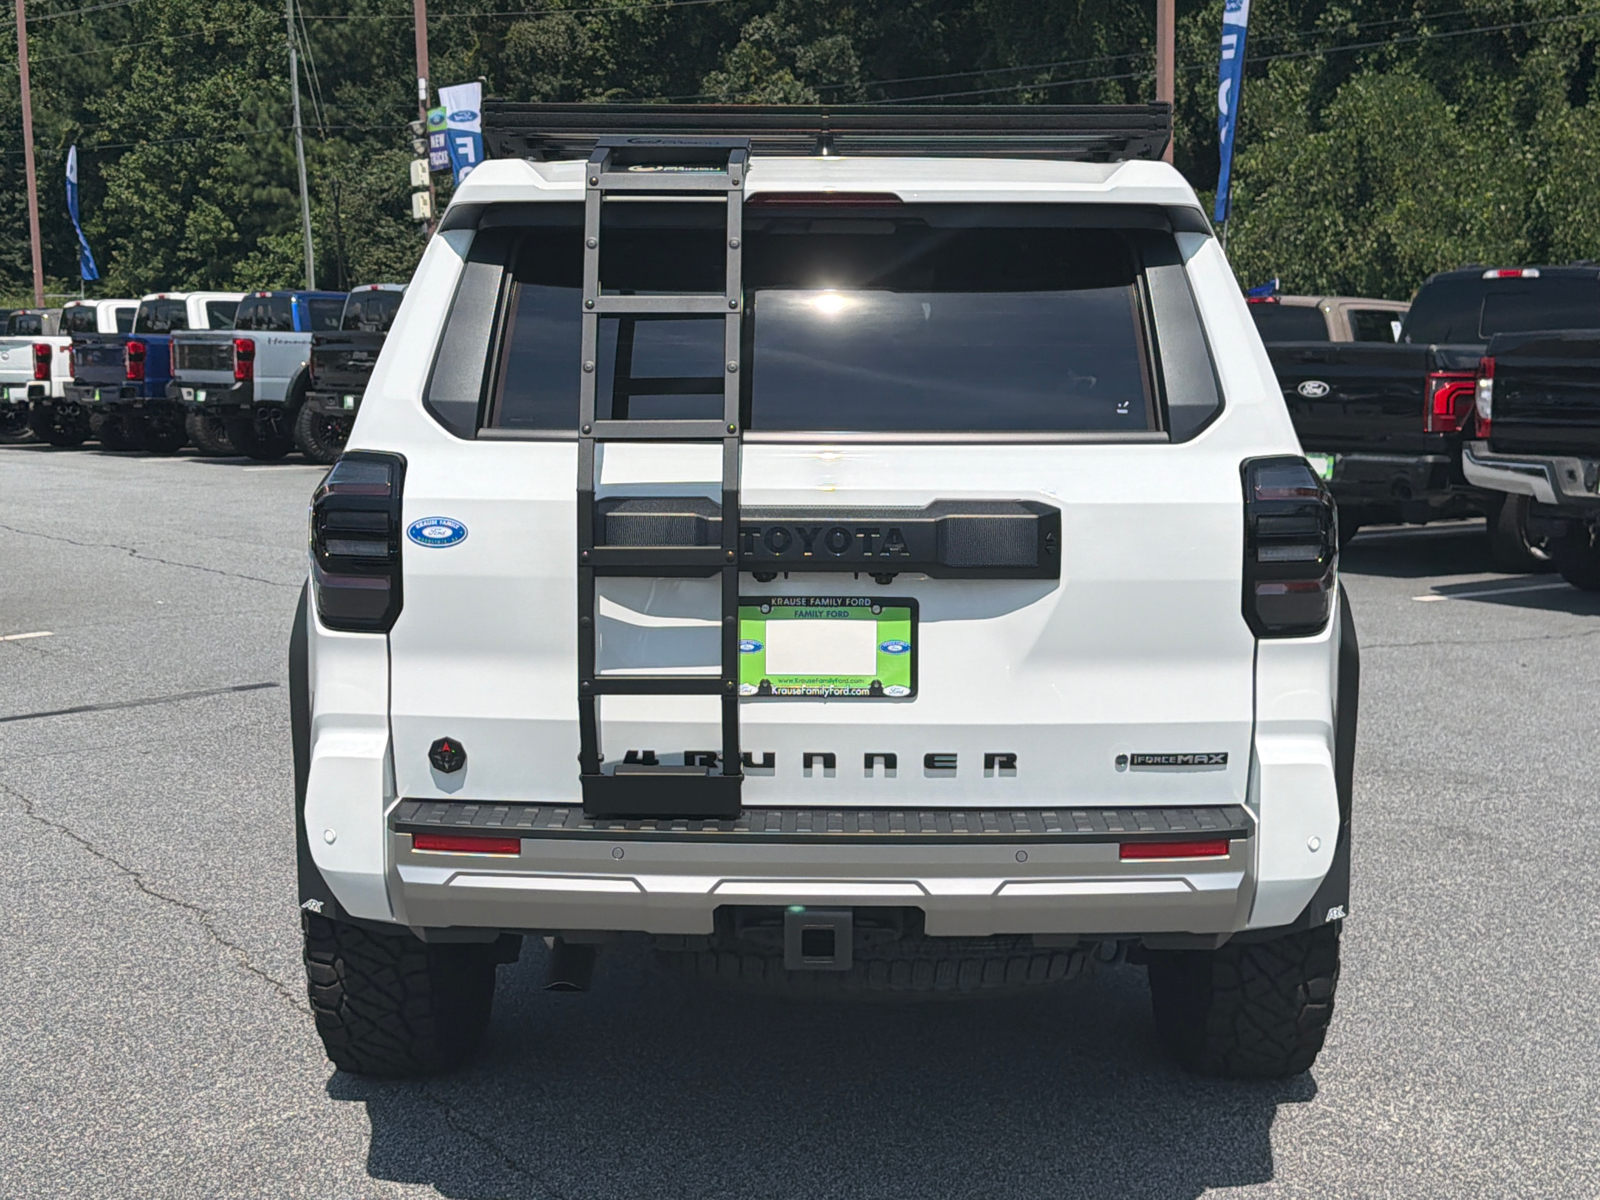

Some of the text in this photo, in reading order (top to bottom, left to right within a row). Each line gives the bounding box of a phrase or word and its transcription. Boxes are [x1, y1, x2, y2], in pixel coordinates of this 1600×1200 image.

[430, 133, 445, 149] NEW
[739, 526, 911, 556] TOYOTA
[771, 598, 871, 606] KRAUSE FAMILY FORD
[771, 685, 870, 698] KrauseFamilyFord.com
